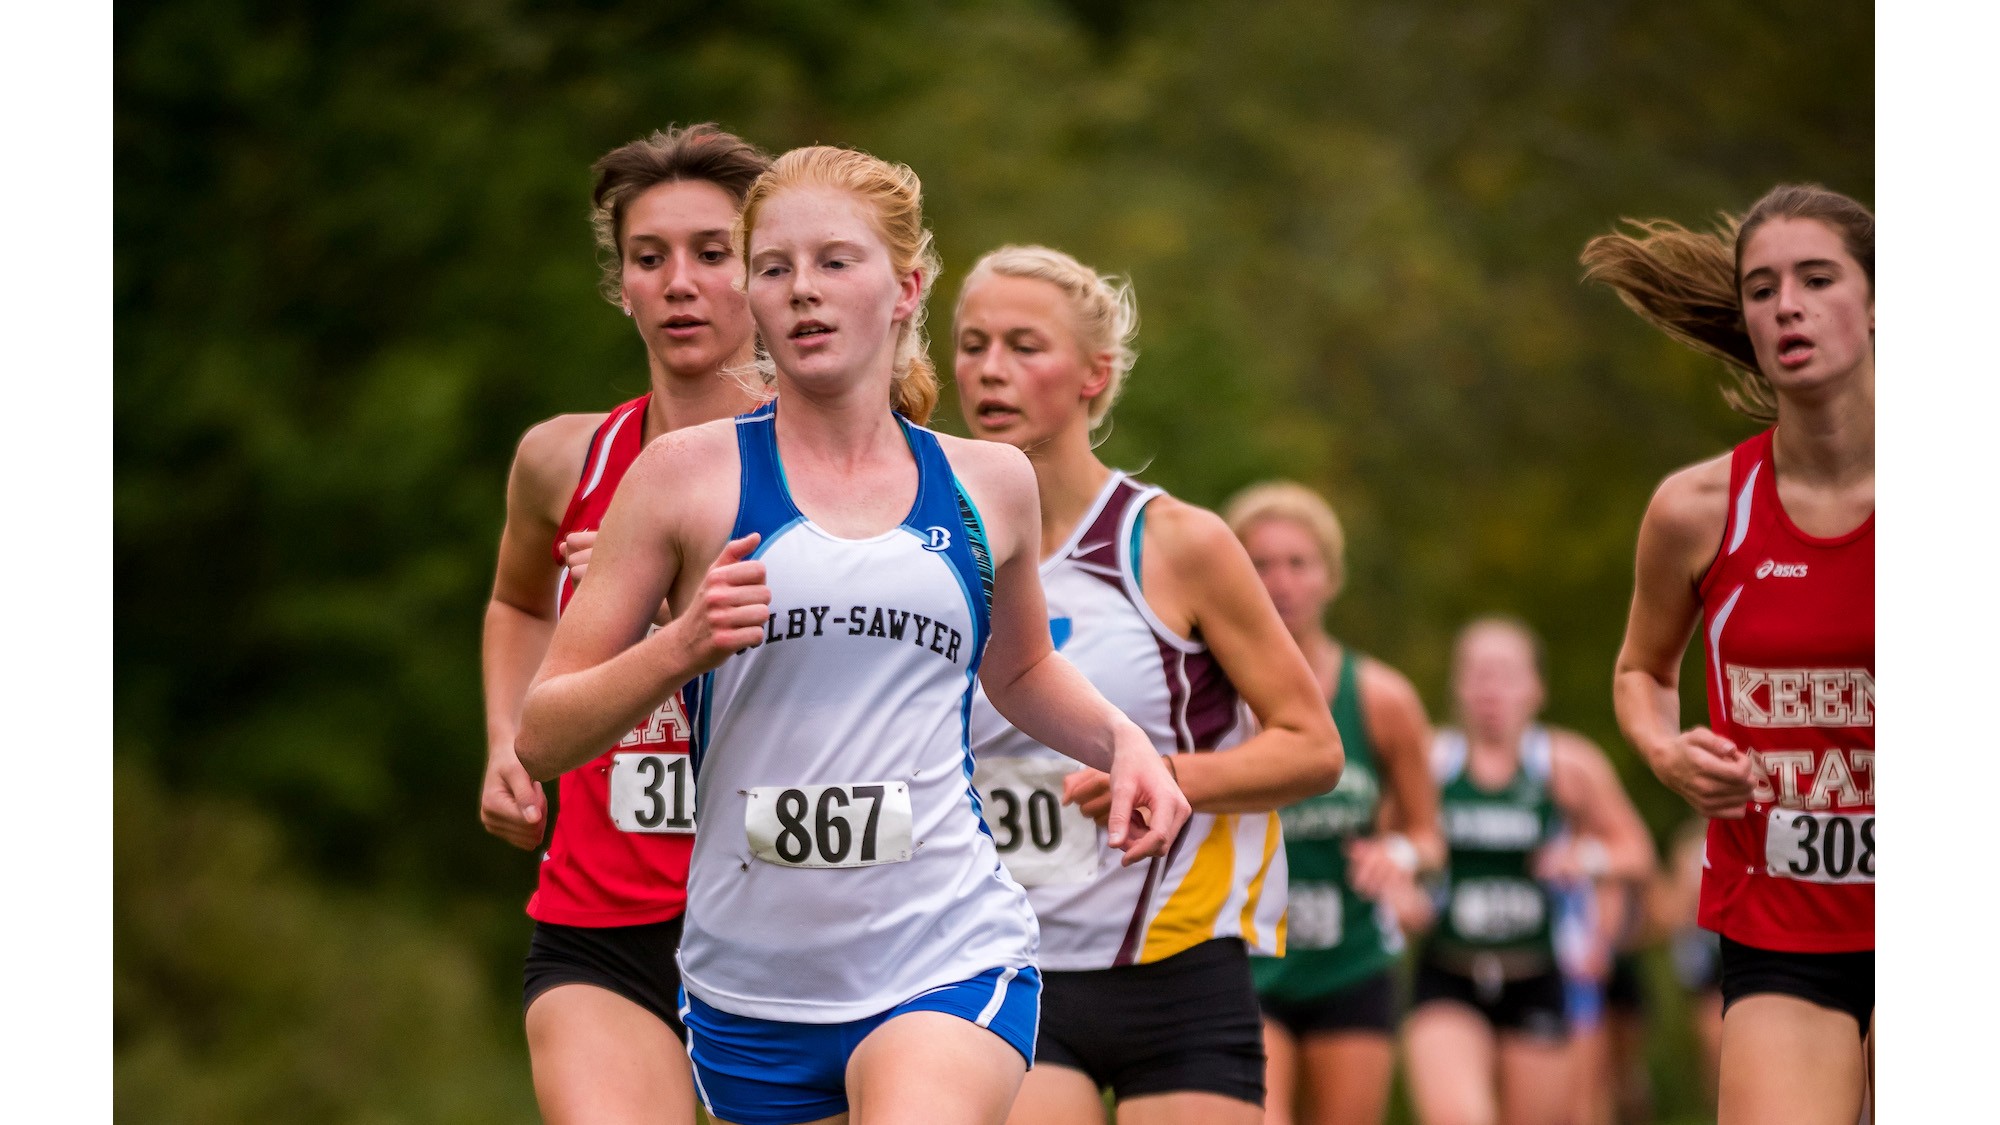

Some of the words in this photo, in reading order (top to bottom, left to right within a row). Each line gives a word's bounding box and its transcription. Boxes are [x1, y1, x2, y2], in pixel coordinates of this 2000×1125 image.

[1772, 563, 1809, 578] asics
[736, 606, 962, 664] LBY-SAWYER
[634, 756, 698, 829] 31
[775, 785, 885, 864] 867
[990, 787, 1063, 855] 30
[1788, 815, 1875, 879] 308
